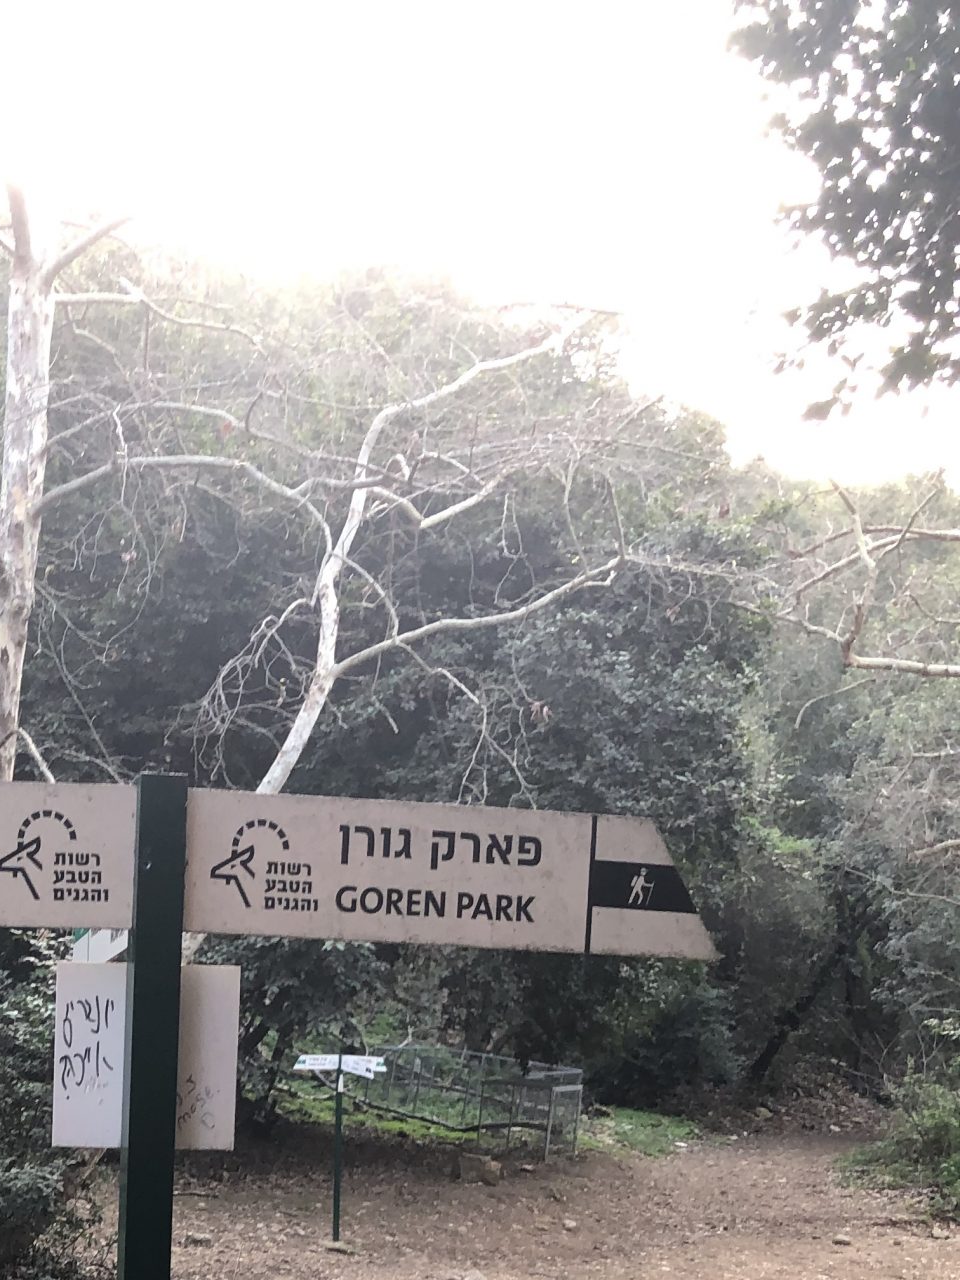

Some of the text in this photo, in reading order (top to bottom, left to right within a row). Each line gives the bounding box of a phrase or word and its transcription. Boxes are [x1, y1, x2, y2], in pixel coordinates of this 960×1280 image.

[339, 824, 543, 870] פארק גורן
[53, 852, 101, 867] רשות
[265, 861, 312, 876] רשות
[53, 870, 102, 884] הטבע
[264, 879, 313, 894] הטבע
[53, 887, 109, 902] והגנים
[264, 896, 319, 912] והגנים
[335, 886, 536, 922] GOREN PARK
